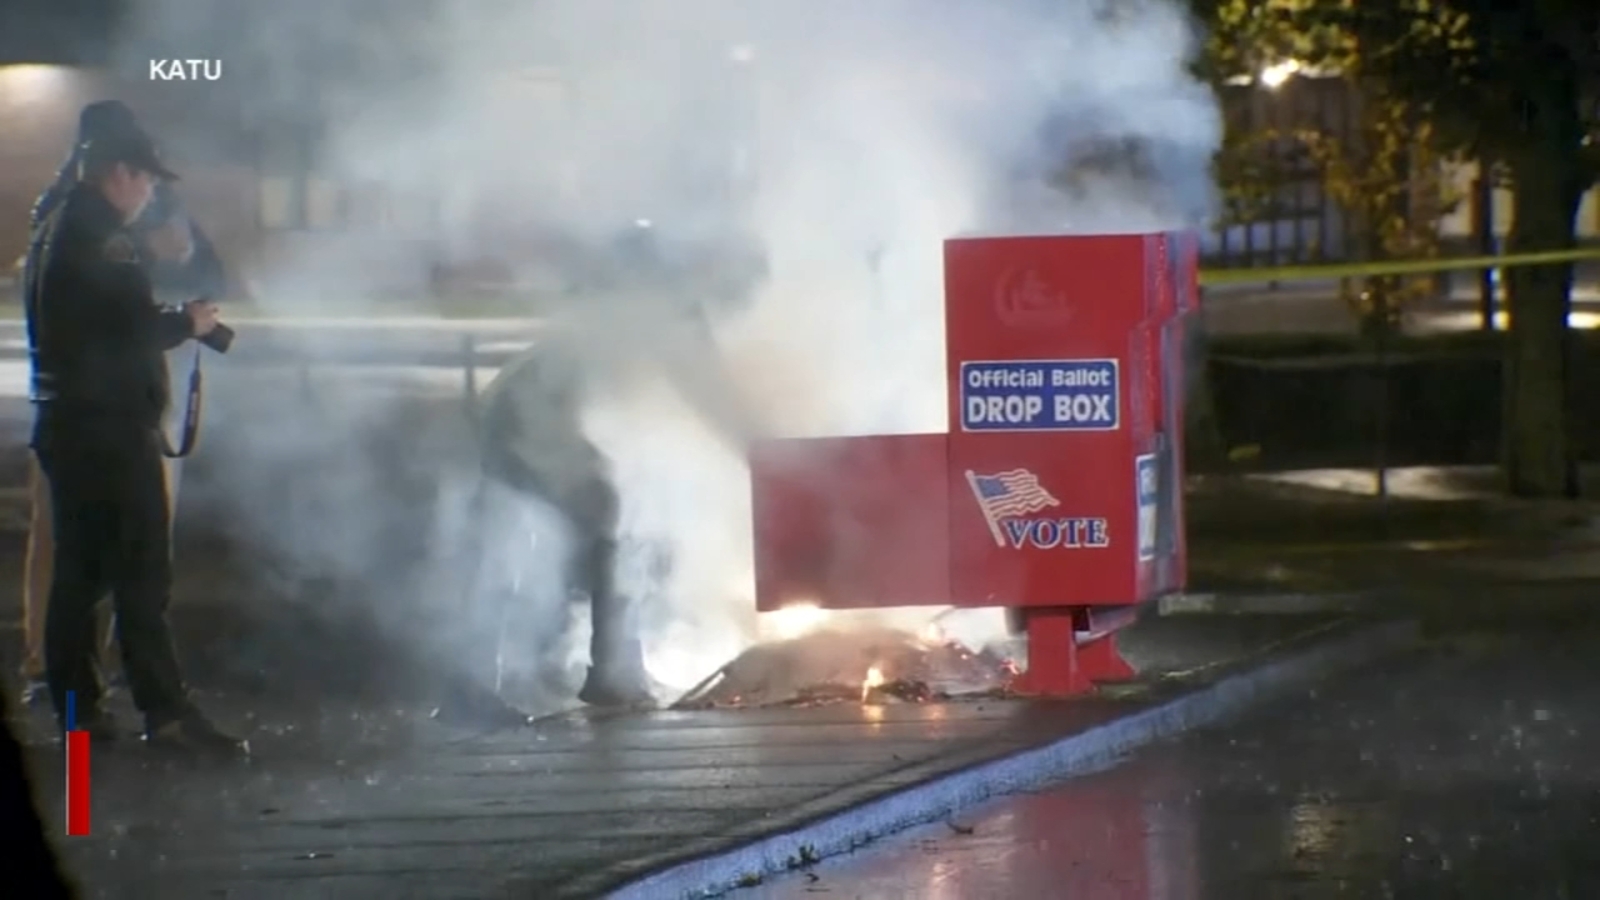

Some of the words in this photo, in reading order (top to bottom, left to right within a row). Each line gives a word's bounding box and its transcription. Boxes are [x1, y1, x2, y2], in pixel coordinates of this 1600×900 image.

[968, 369, 1044, 388] Official
[1051, 368, 1111, 387] Ballot
[967, 395, 1043, 423] DROP
[1053, 394, 1111, 422] BOX
[1002, 517, 1109, 549] VOTE
